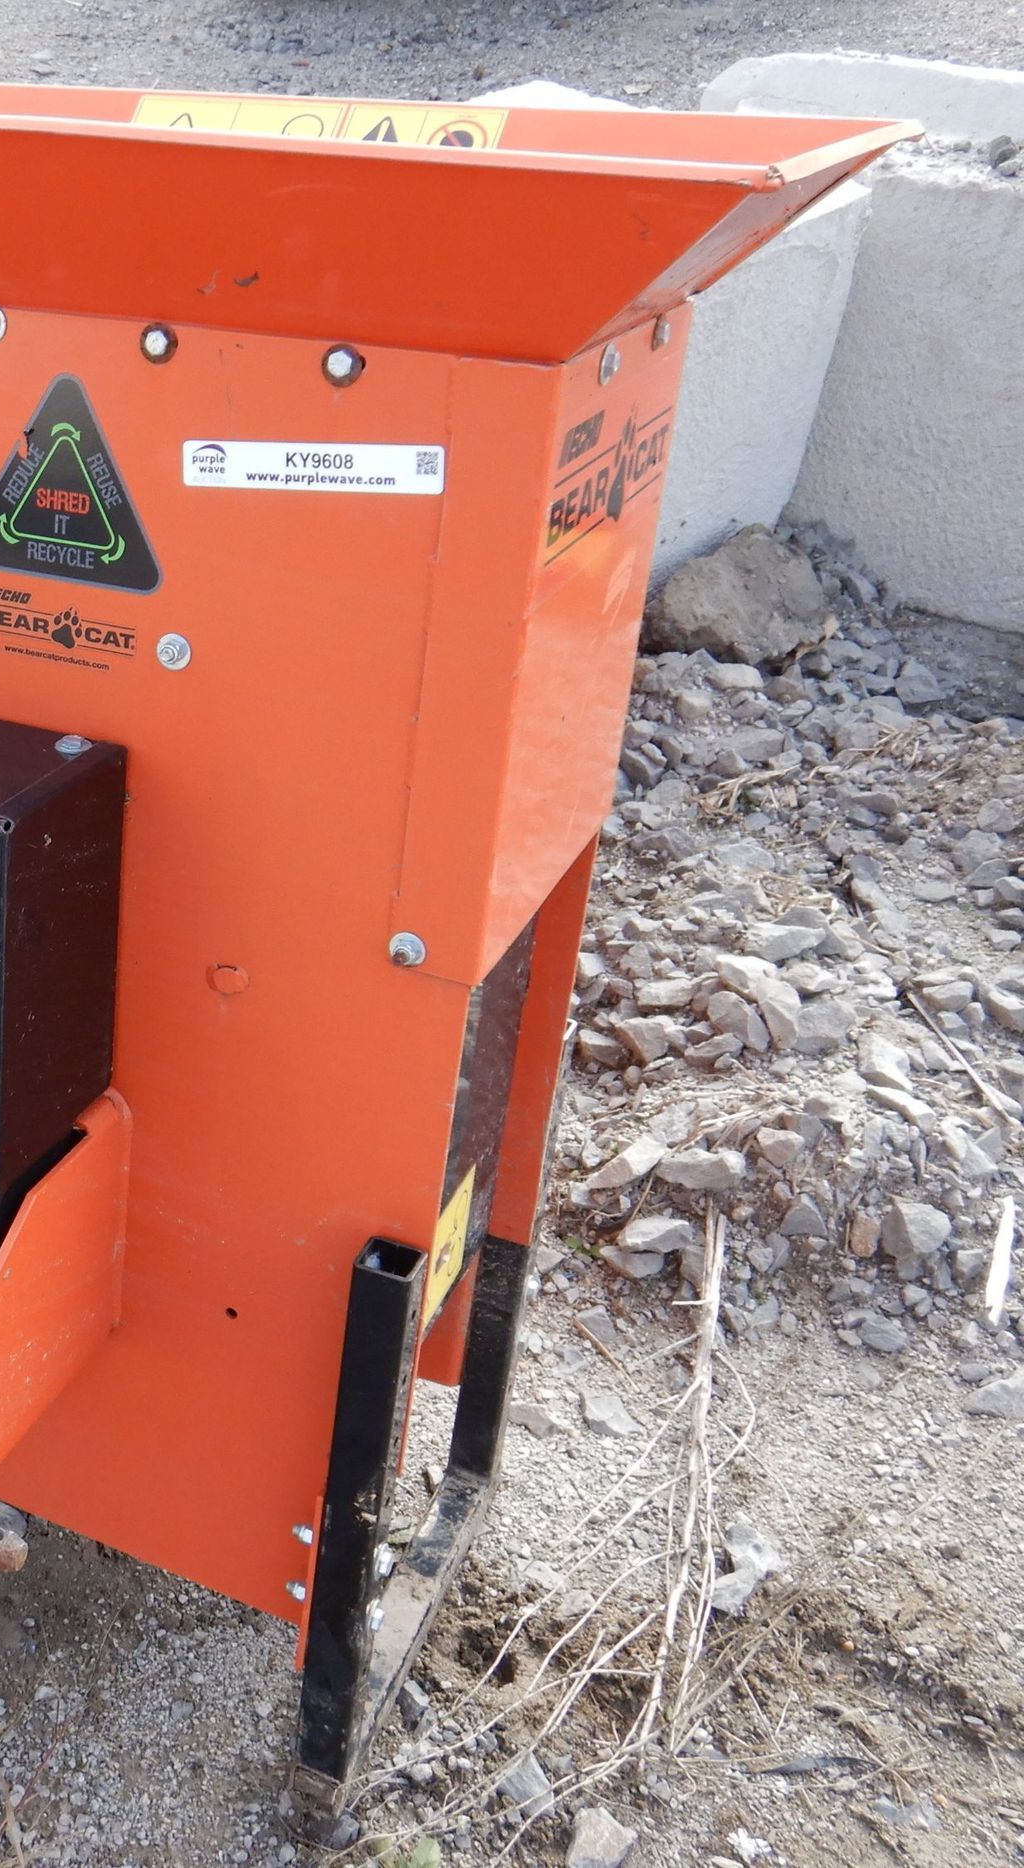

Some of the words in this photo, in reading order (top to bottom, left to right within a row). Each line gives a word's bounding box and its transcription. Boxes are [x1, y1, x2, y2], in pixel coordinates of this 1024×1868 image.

[192, 453, 226, 465] purple
[199, 466, 226, 474] wave
[285, 452, 354, 470] KY9608
[2, 442, 46, 506] REDUCE
[87, 453, 123, 510] REUSE
[246, 471, 396, 487] www.purplewave.com
[547, 467, 610, 548] BEAR
[633, 424, 669, 482] CAT
[36, 488, 91, 514] SHRED
[54, 514, 70, 535] IT
[27, 541, 95, 569] RECYCLE
[84, 627, 136, 650] CAT
[4, 644, 111, 671] www.bearcatproducts.com
